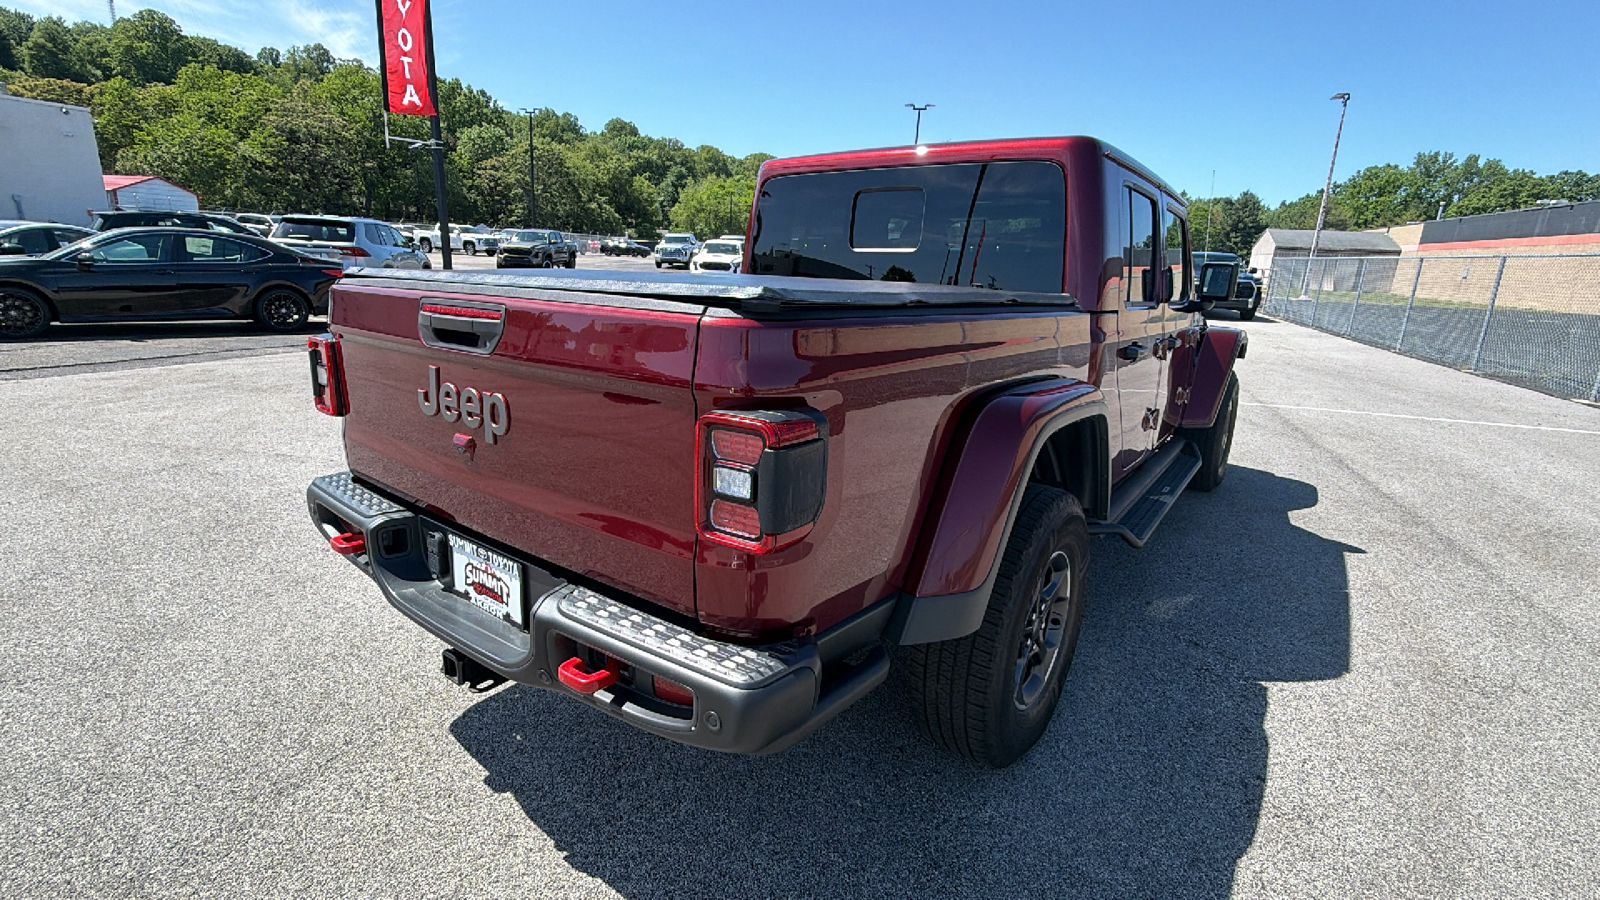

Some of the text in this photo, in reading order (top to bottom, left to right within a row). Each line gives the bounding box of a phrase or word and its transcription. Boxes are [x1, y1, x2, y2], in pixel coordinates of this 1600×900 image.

[417, 364, 511, 445] Jeep
[448, 533, 519, 577] SUMMIT TOYOTA
[466, 564, 508, 604] SUMMIT
